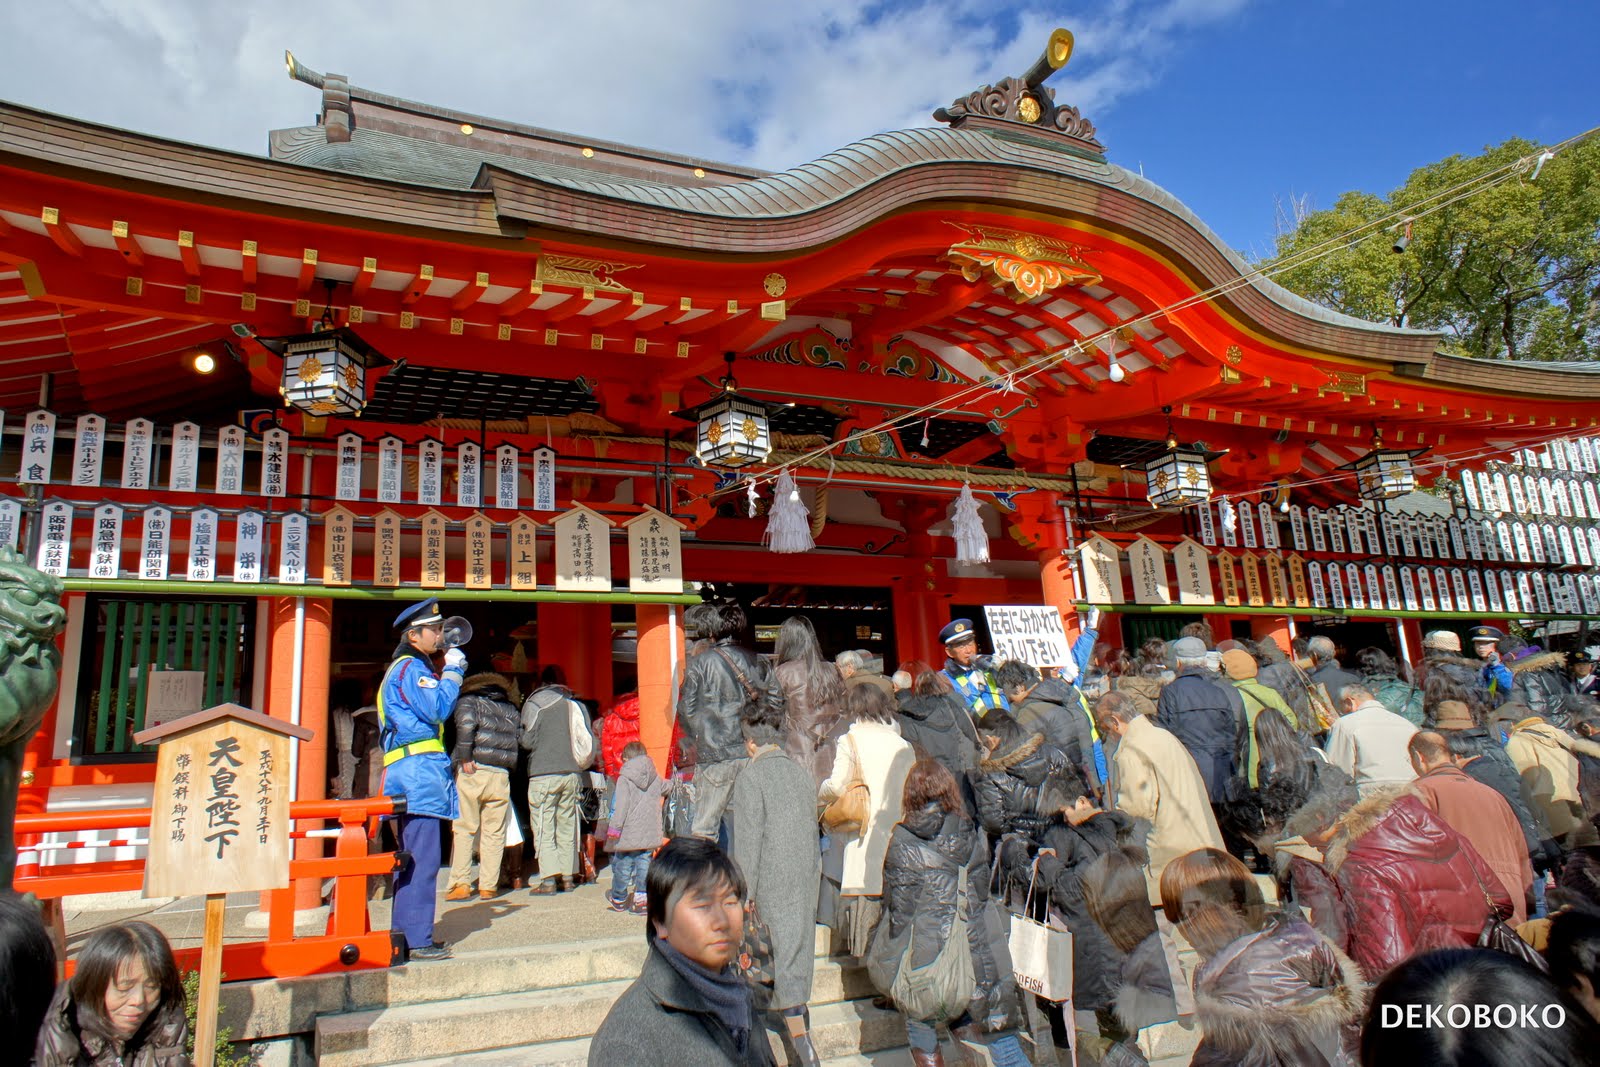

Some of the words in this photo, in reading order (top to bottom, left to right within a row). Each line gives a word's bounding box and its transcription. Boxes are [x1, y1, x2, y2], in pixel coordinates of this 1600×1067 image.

[221, 438, 239, 490] (株)大林組
[266, 441, 282, 495] 清水建設(株)
[94, 518, 117, 576] 阪急電鉄(株)
[146, 520, 165, 578] (株)日能研関西
[193, 523, 211, 579] 塩屋土地(株)
[239, 522, 258, 580] 神栄(株)
[427, 529, 441, 583] (株)新生公司
[471, 531, 485, 584] (株)竹中工務店
[517, 551, 532, 585] 上組
[987, 607, 1064, 635] 左右に分かれて
[995, 638, 1061, 665] お入り下さい
[204, 737, 244, 860] 天皇陛下
